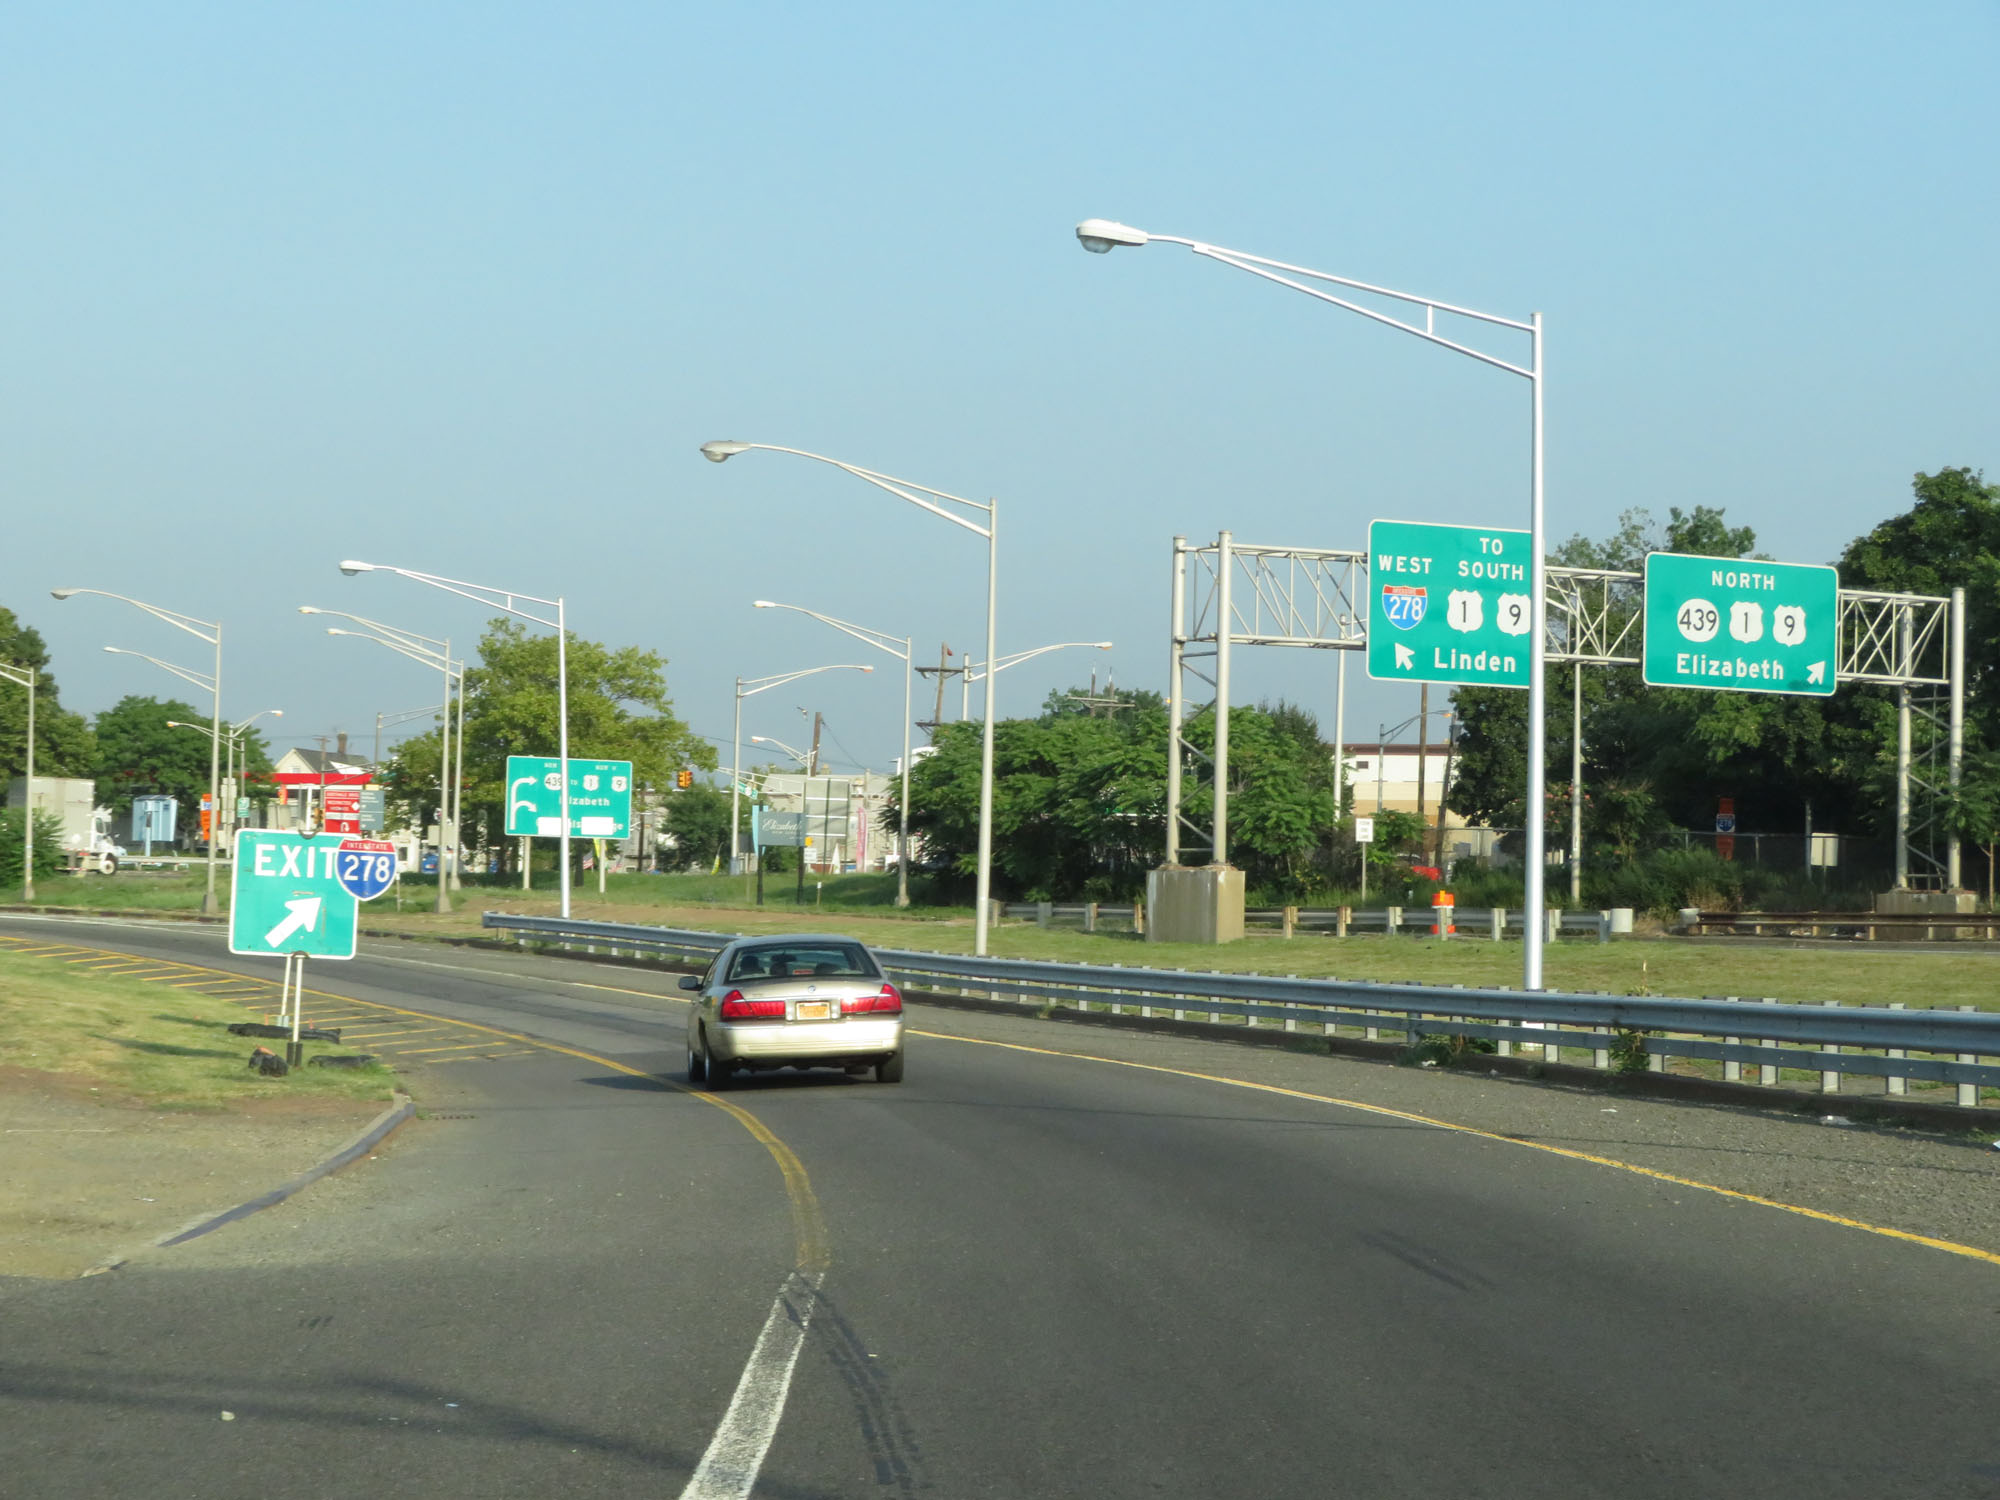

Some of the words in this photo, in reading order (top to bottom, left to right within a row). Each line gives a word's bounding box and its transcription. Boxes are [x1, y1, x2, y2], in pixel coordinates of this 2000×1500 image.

[1480, 537, 1504, 555] TO
[1378, 554, 1433, 575] WEST
[1457, 560, 1524, 581] SOUTH
[1711, 570, 1775, 591] NORTH
[1389, 595, 1423, 621] 278
[1461, 600, 1467, 624] 1
[1509, 603, 1522, 627] 9
[1678, 607, 1718, 632] 439
[1743, 611, 1749, 634] 1
[1783, 614, 1796, 637] 9
[1433, 646, 1517, 673] Linden
[1676, 652, 1784, 680] Elizabeth
[616, 779, 623, 789] 9
[558, 796, 610, 806] izabeth
[254, 843, 340, 880] EXIT
[343, 854, 390, 883] 278
